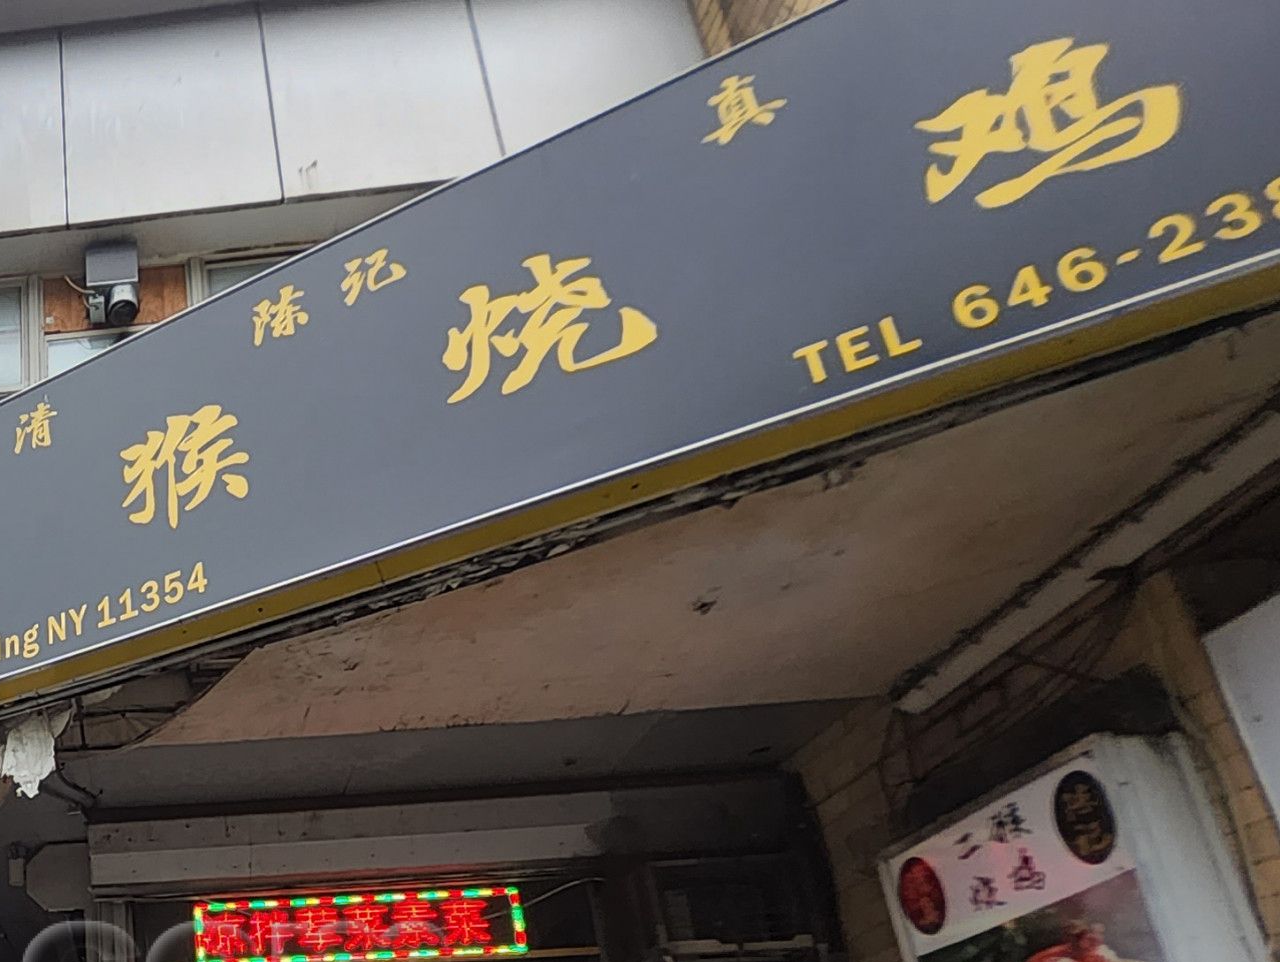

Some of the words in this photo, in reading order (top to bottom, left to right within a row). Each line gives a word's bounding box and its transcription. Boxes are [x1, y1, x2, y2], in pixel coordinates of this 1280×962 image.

[701, 74, 788, 145] 真
[792, 315, 923, 385] TEL
[14, 401, 58, 454] 清
[47, 604, 88, 645] NY
[98, 561, 209, 629] 11354
